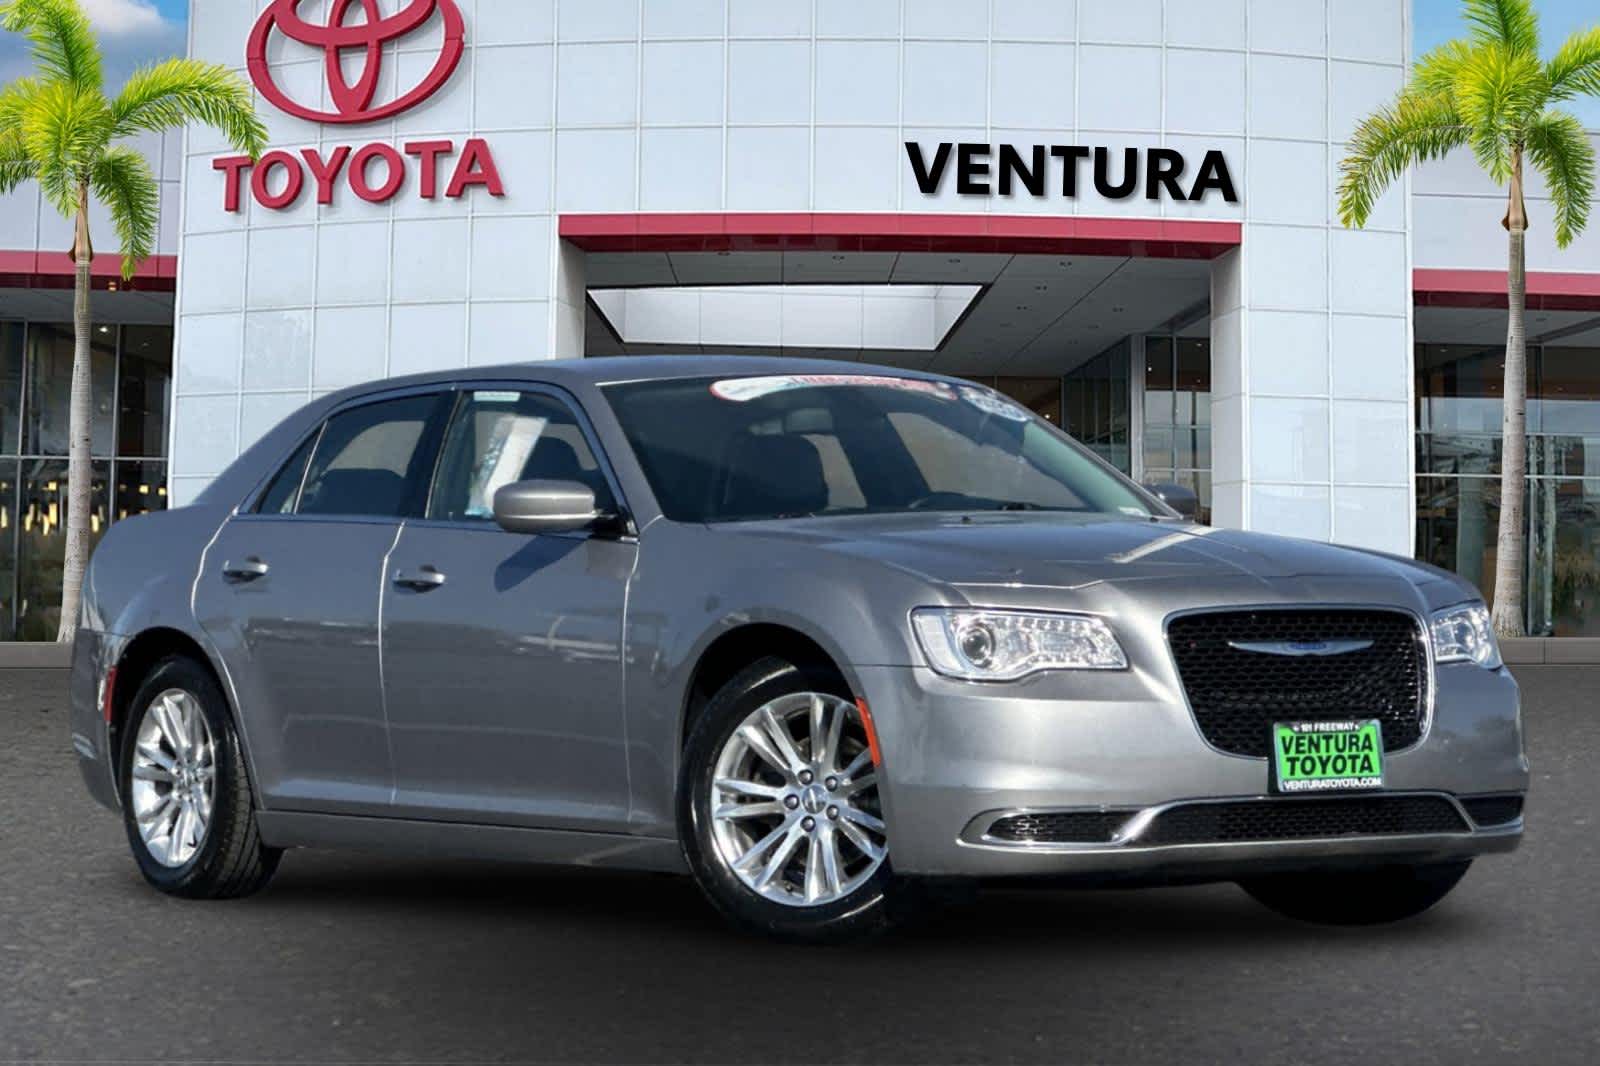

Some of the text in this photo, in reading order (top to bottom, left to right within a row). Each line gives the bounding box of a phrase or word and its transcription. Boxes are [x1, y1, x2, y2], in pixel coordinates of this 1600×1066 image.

[213, 138, 505, 212] TOYOTA
[905, 142, 1239, 203] VENTURA
[1281, 733, 1374, 755] VENTURA
[1286, 755, 1374, 776] TOYOTA
[1283, 778, 1382, 790] VENTURATOYOTA.COM
